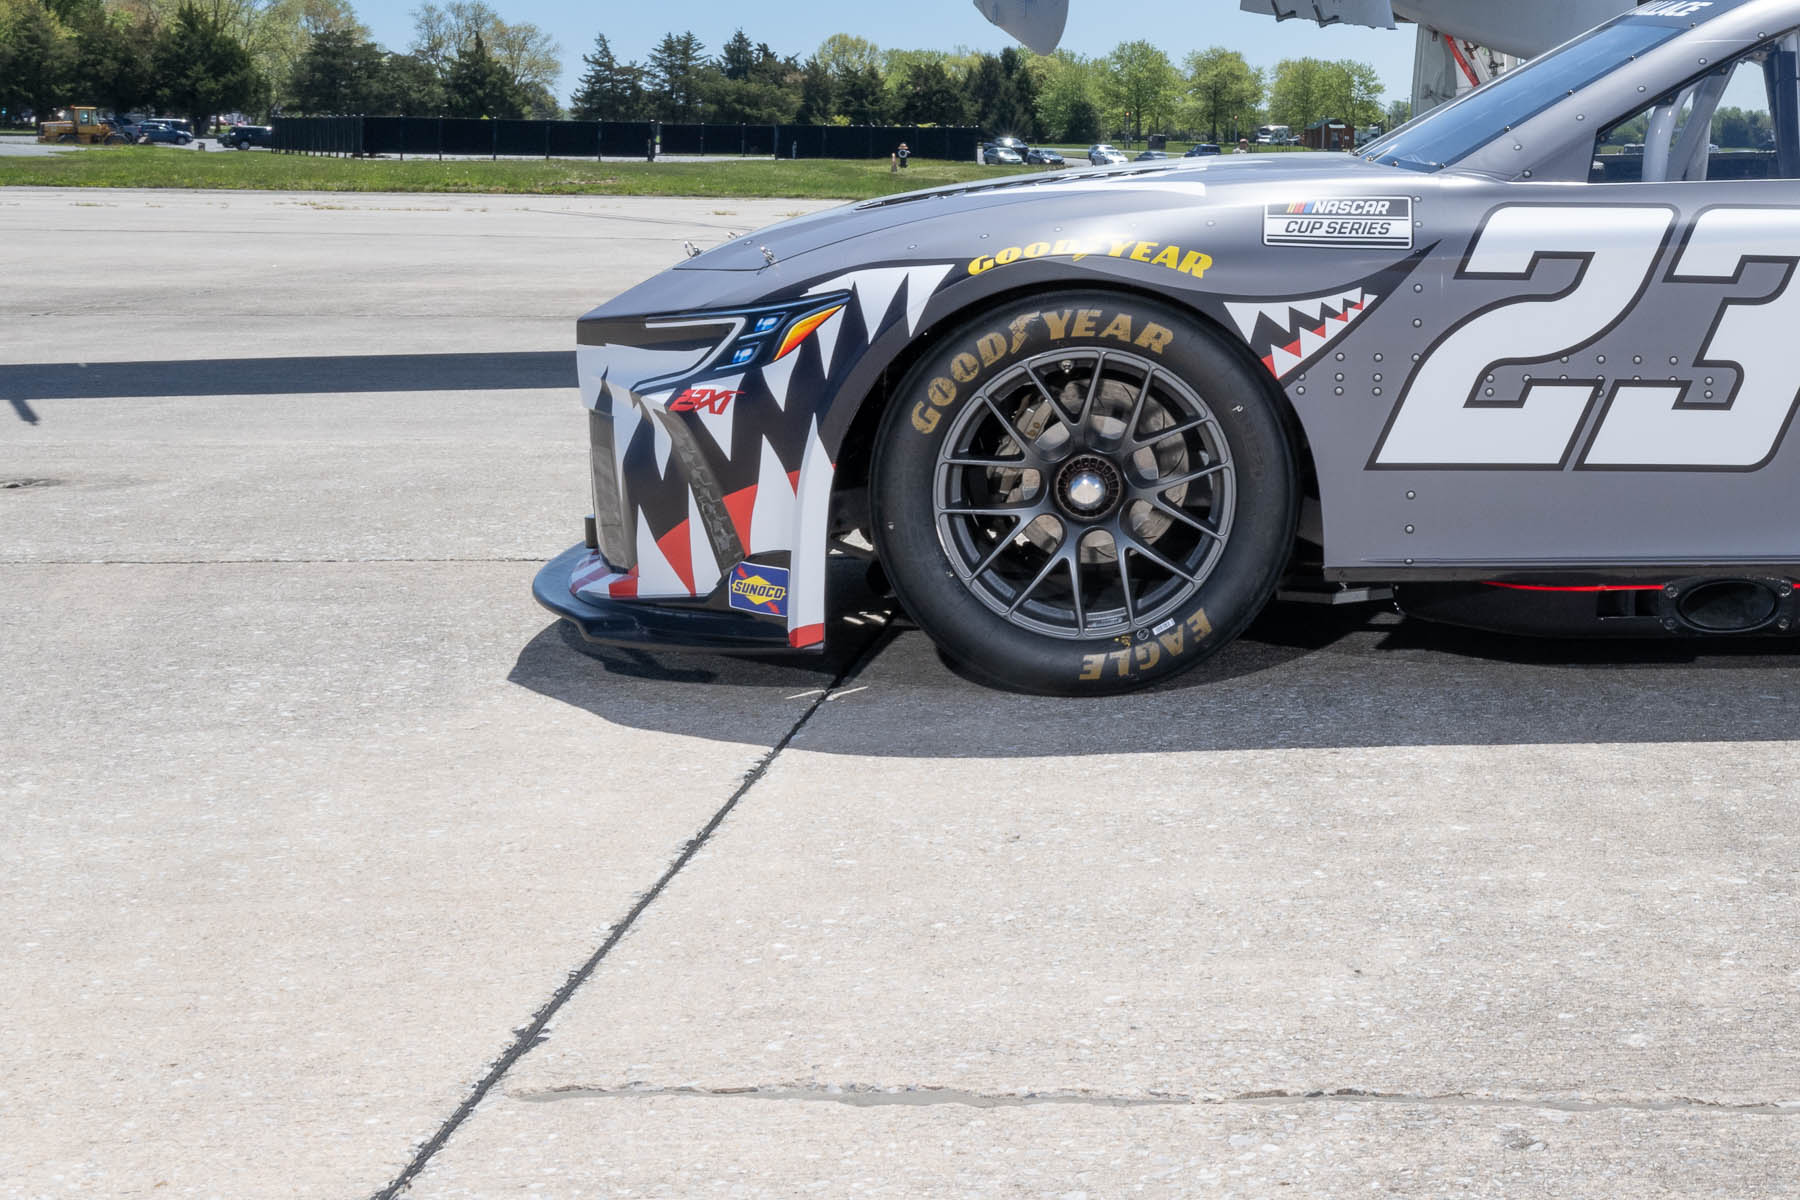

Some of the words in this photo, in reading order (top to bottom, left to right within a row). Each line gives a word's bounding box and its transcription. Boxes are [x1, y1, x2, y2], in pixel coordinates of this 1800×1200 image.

[1311, 201, 1390, 214] NASCAR
[1285, 221, 1324, 234] CUP
[1325, 221, 1391, 235] SERIES
[734, 581, 784, 599] SUNOCO
[1079, 608, 1212, 680] EAGLE
